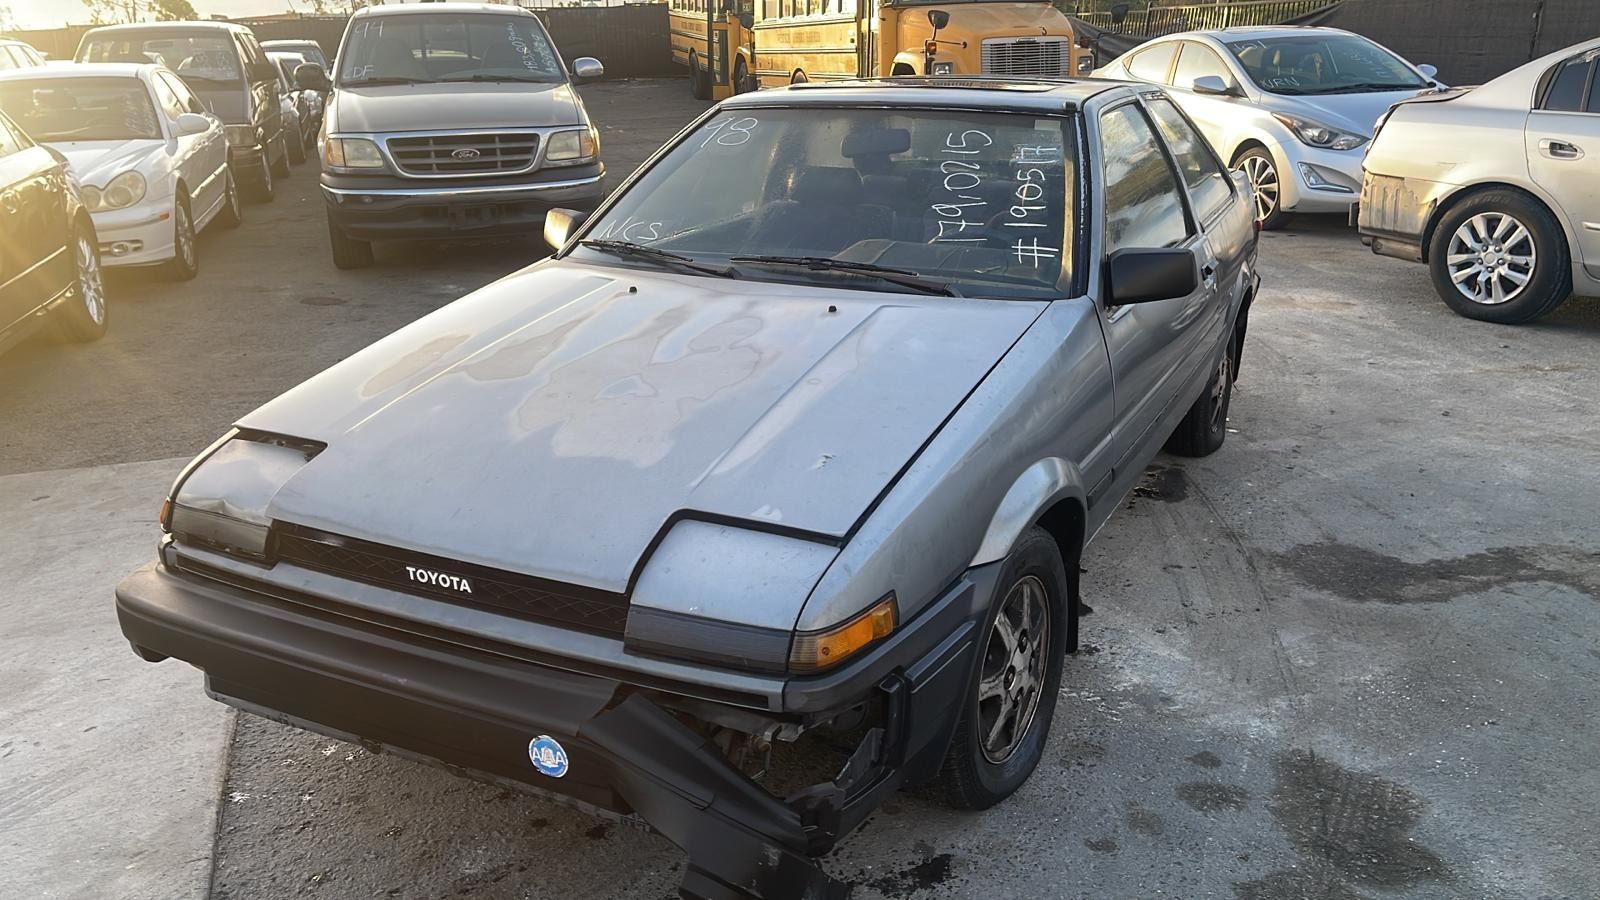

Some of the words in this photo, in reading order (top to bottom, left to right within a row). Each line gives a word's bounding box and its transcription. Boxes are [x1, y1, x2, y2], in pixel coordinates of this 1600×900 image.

[701, 117, 759, 149] 98
[599, 216, 663, 241] NCS
[405, 566, 472, 593] TOYOTA
